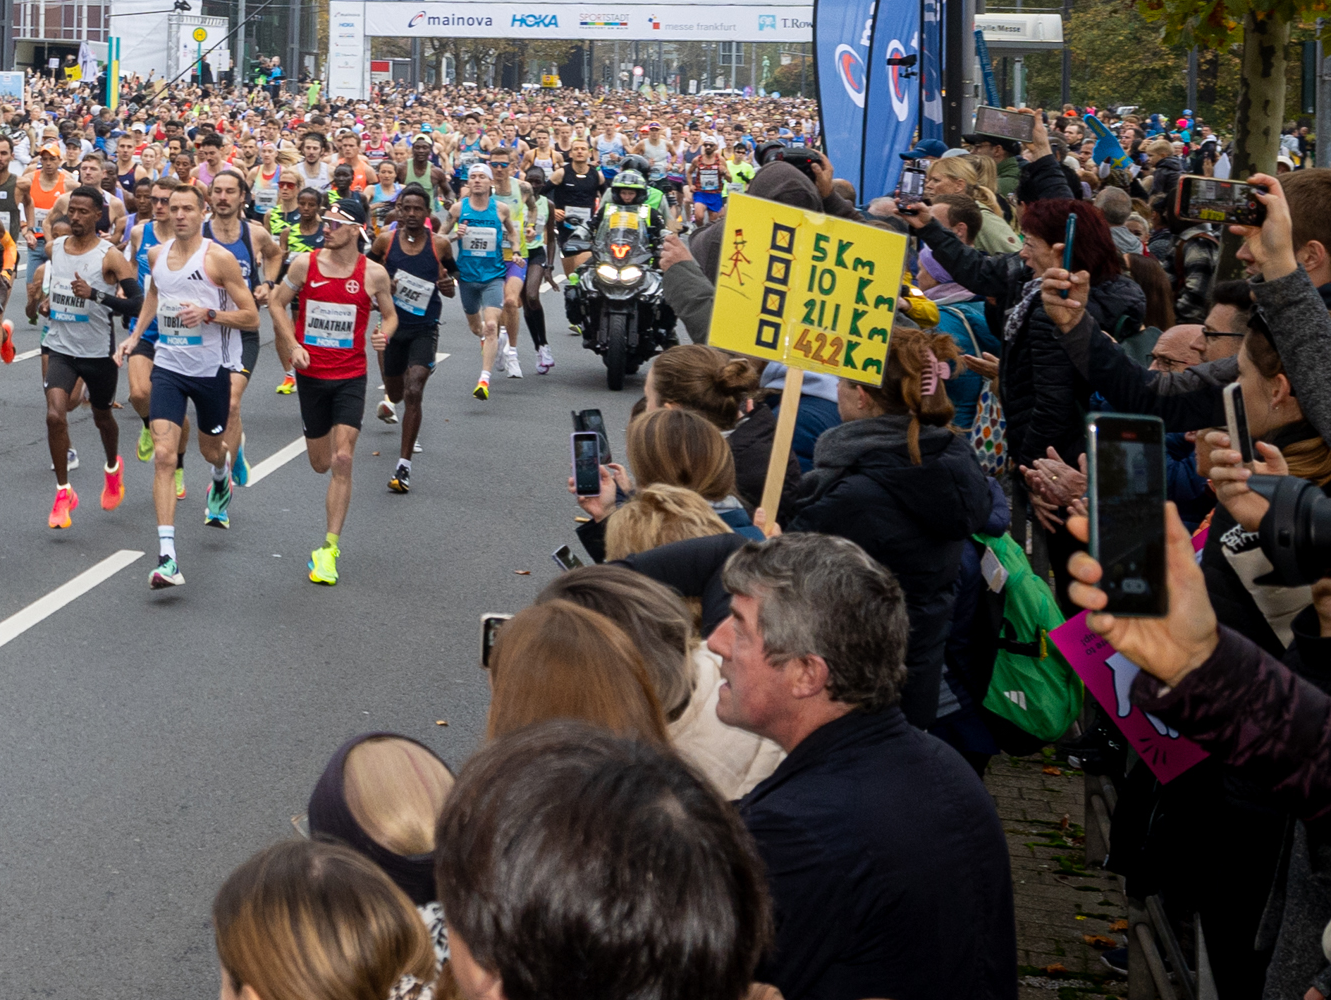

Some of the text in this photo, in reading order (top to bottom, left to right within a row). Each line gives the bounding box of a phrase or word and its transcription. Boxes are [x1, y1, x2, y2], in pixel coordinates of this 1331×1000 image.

[428, 14, 559, 28] mainova HOKA
[664, 21, 737, 32] messe frankfurt
[811, 232, 830, 263] 5
[807, 264, 837, 296] 10
[399, 286, 422, 302] PACE
[319, 307, 351, 316] mainova
[801, 298, 841, 332] 21,1
[307, 317, 353, 332] JONATHAN
[166, 335, 188, 345] HOKA
